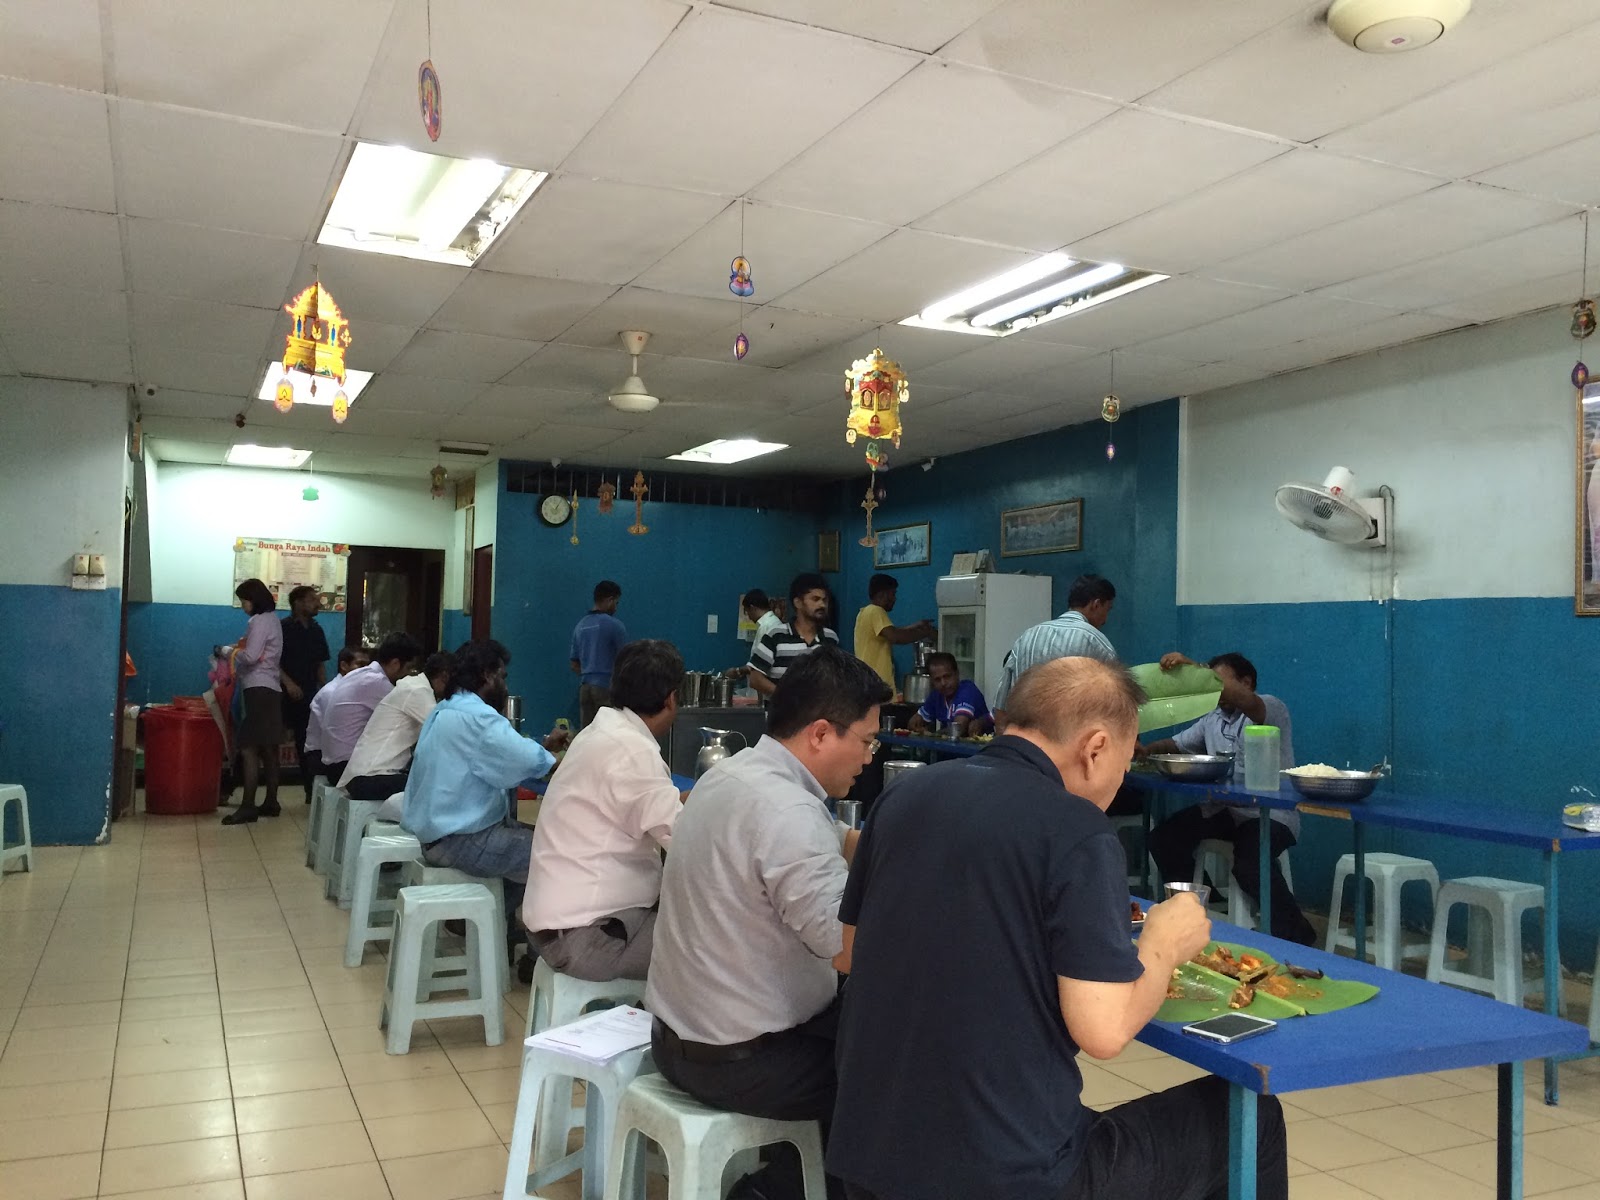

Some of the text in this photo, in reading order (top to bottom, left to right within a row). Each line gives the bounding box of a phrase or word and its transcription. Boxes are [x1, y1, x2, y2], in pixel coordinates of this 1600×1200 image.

[258, 541, 331, 553] Bunga Raya Indah
